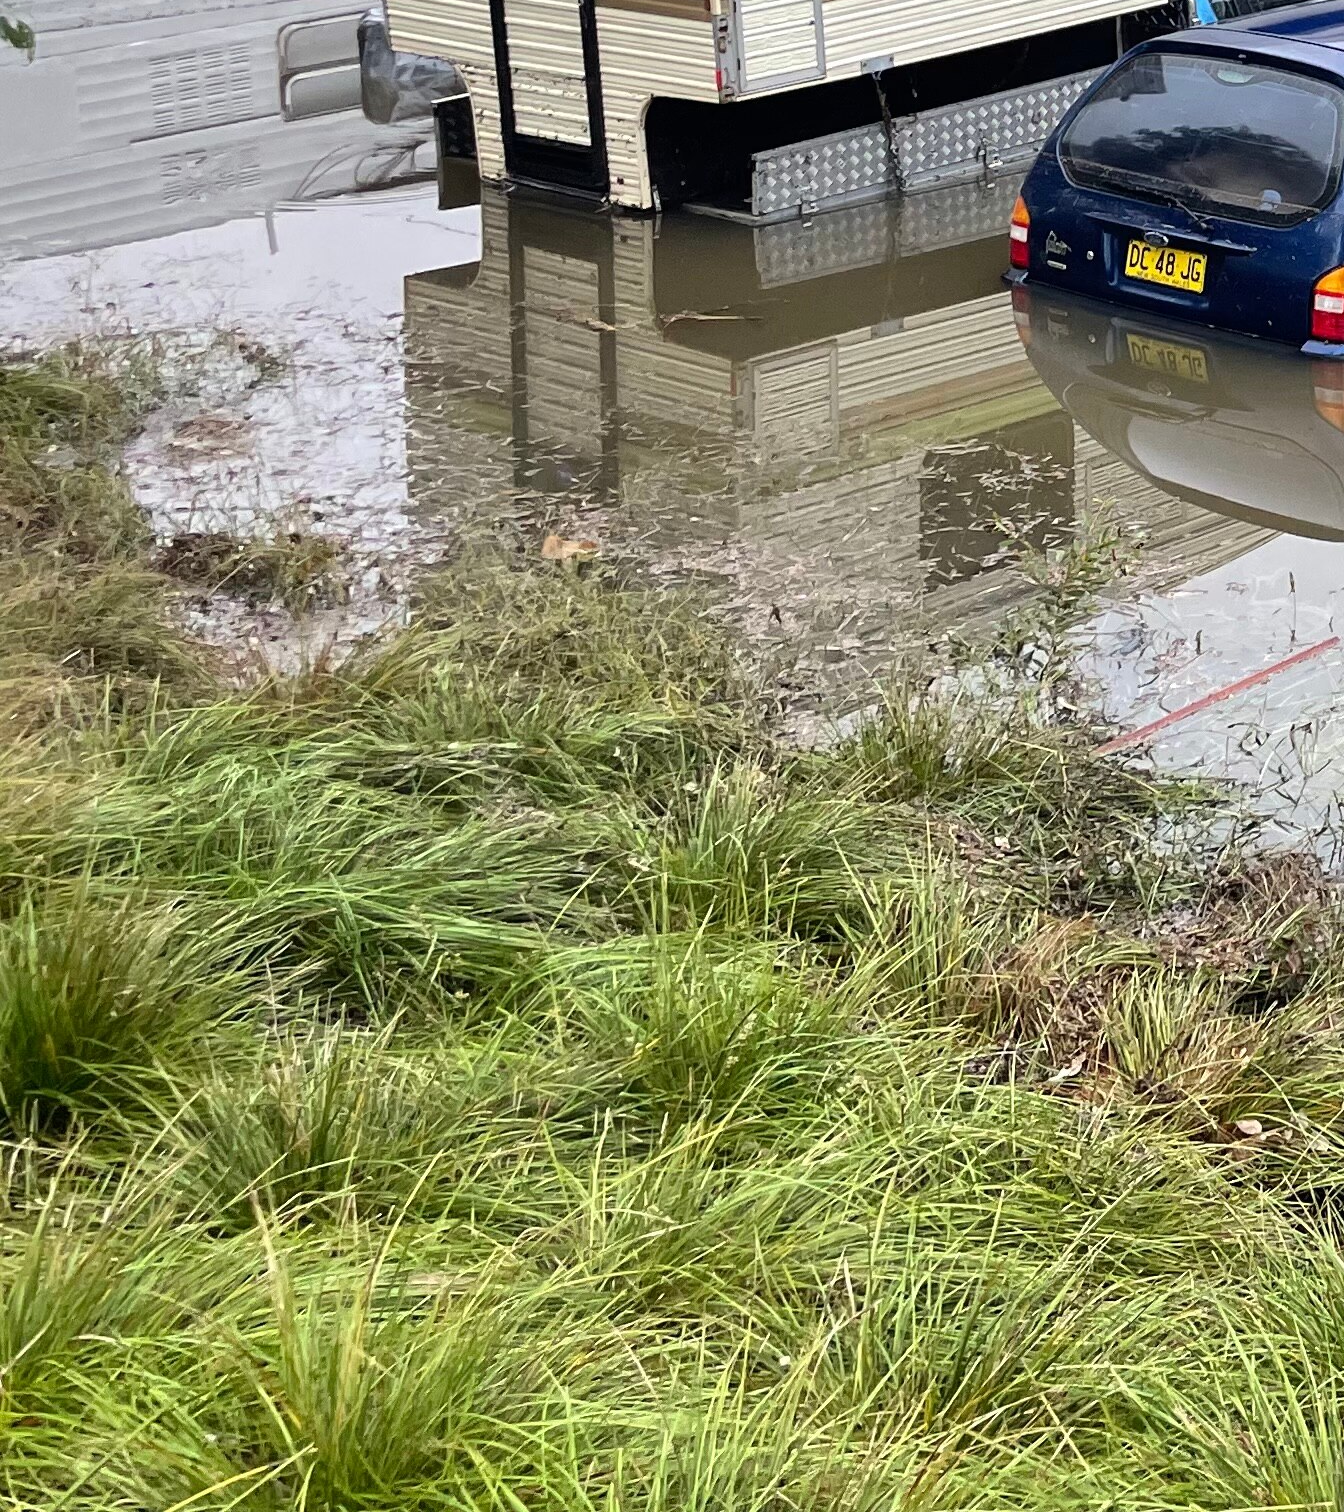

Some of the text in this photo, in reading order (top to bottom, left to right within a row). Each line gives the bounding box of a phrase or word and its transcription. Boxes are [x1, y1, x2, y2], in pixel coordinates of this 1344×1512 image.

[1129, 244, 1201, 282] DC 48 JG
